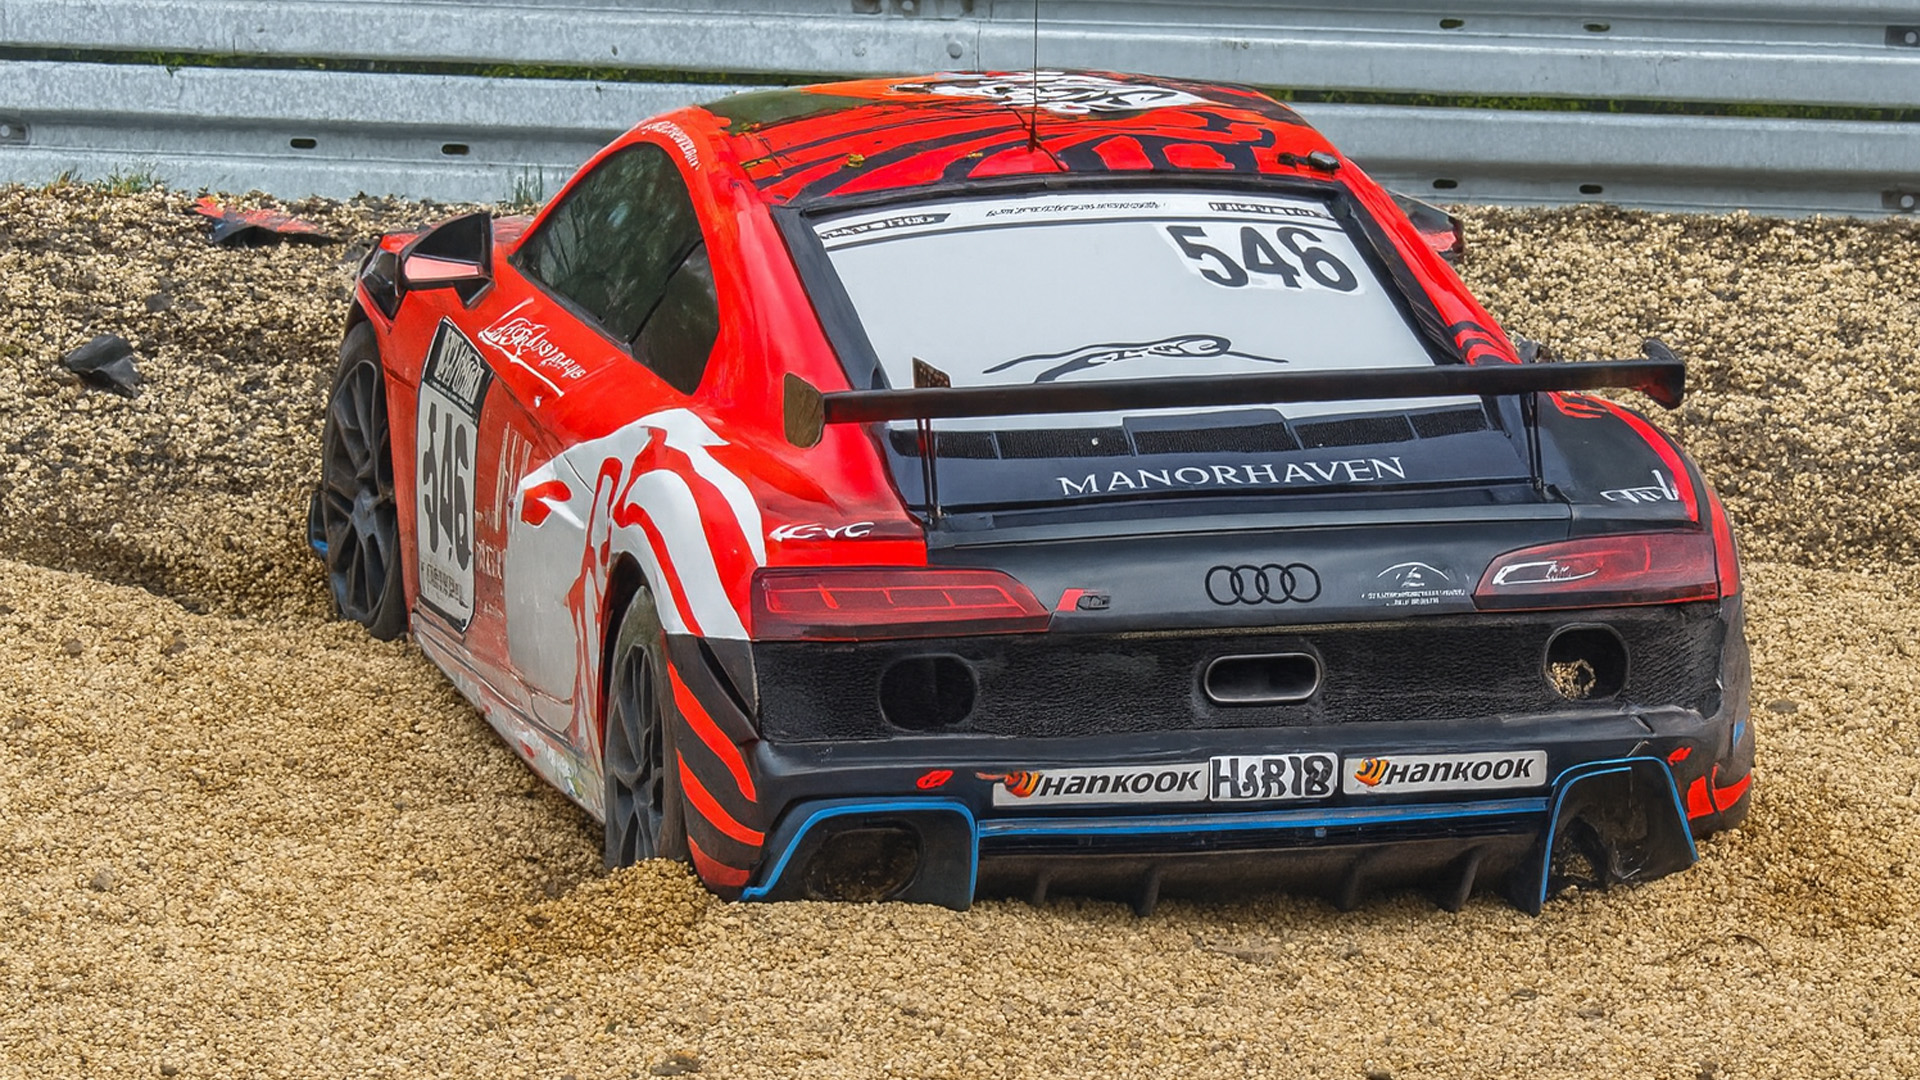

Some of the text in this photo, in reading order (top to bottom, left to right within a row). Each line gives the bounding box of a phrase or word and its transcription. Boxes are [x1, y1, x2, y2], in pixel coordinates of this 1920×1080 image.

[1167, 225, 1358, 292] 546
[423, 402, 472, 572] 546
[1056, 456, 1406, 496] MANORHAVEN
